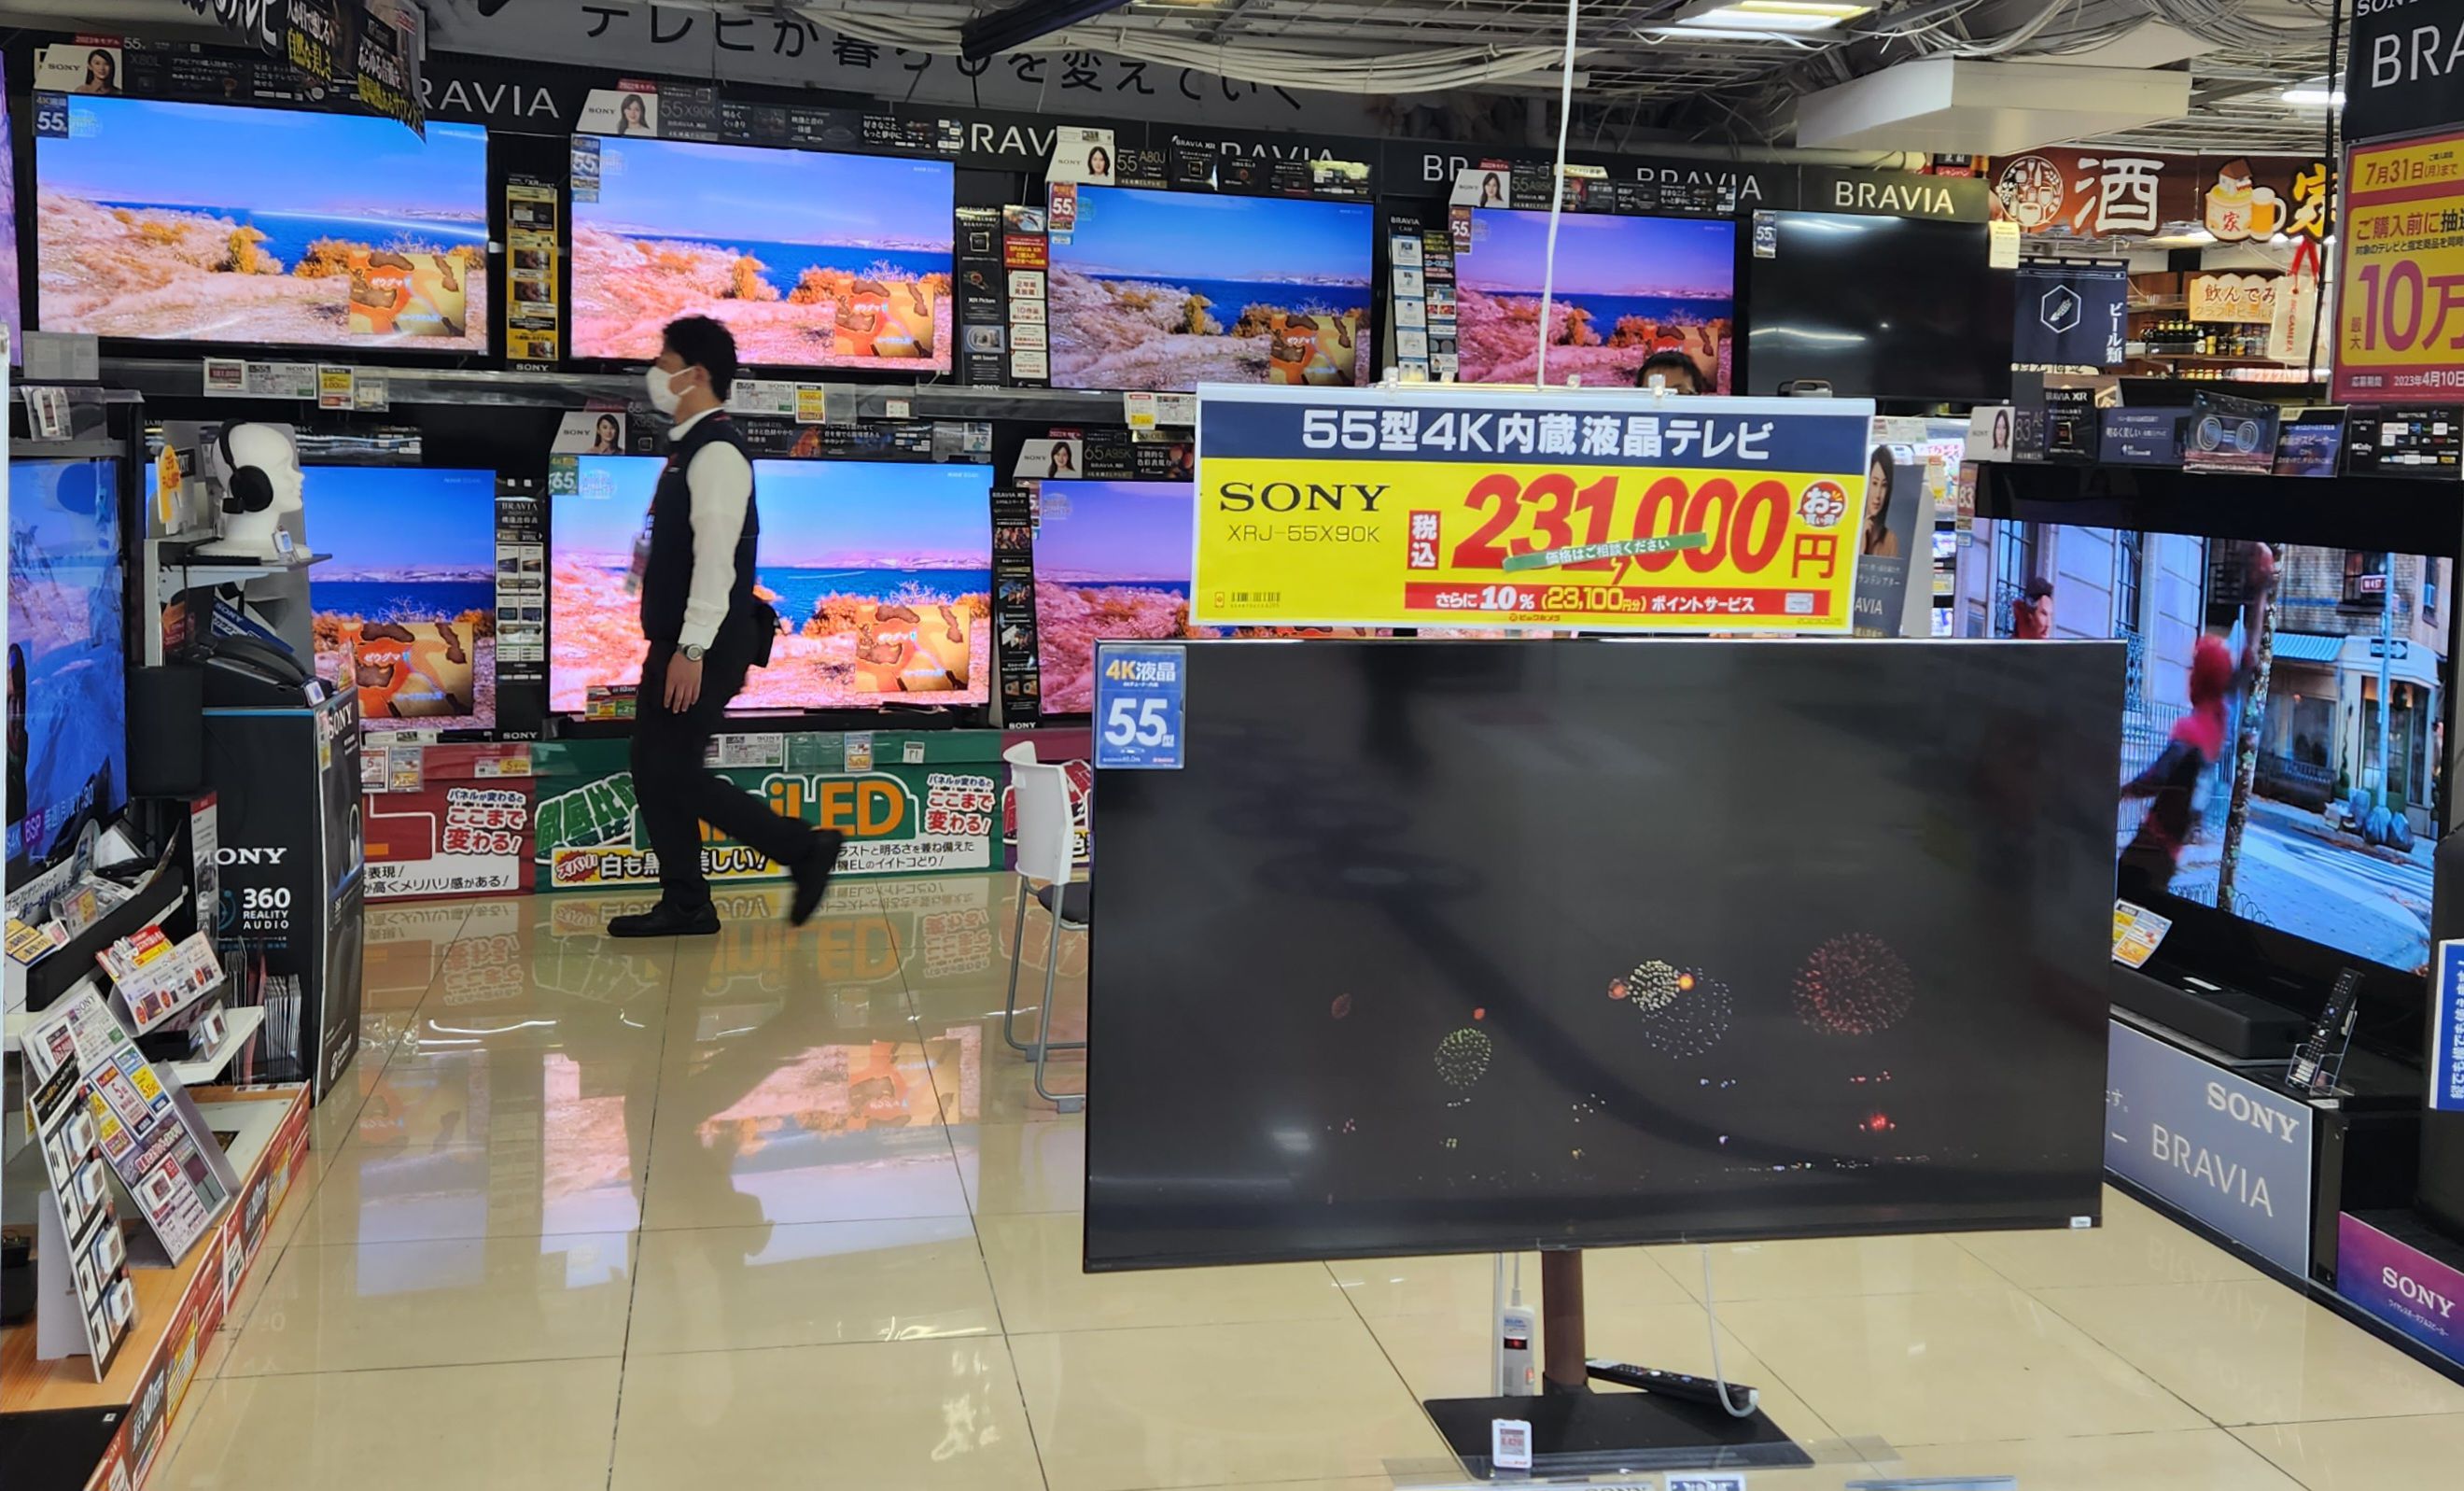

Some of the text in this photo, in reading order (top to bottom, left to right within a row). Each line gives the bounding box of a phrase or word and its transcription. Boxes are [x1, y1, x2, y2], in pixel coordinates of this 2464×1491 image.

[48, 63, 81, 71] SONY
[420, 77, 560, 120] RAVIA
[2365, 158, 2458, 186] 7月31日(月)まで
[1835, 180, 1954, 216] BRAVIA
[2074, 157, 2165, 232] 酒
[1391, 216, 1420, 225] BRAVIA
[2221, 212, 2241, 232] 家
[2357, 207, 2464, 241] ご購入前に抽
[2106, 302, 2123, 363] ビール類
[2350, 316, 2363, 351] 最大
[516, 363, 550, 373] SONY
[2072, 391, 2088, 401] XR
[1302, 409, 1774, 460] 55型4K内蔵液晶テレビ
[501, 501, 539, 511] BRAVIA
[1220, 482, 1391, 512] SONY
[1803, 486, 1843, 514] おっ
[1227, 525, 1380, 543] XRJ-55X90K
[1451, 471, 1791, 585] 231,000
[1409, 513, 1438, 569] 税込
[1546, 539, 1671, 566] 価格はご相談ください
[1792, 533, 1839, 579] 円
[1651, 596, 1756, 612] ポイントサービス
[1105, 658, 1177, 682] 4K液晶
[328, 701, 354, 739] SONY
[1009, 722, 1036, 730] SONY
[502, 731, 539, 739] SONY
[928, 774, 992, 788] パネルが変わると
[449, 790, 524, 804] パネルが変わると
[928, 791, 993, 810] ここまで
[448, 807, 525, 827] ここまで
[926, 810, 991, 834] 変わる!
[446, 827, 520, 851] 変わる!
[215, 847, 287, 866] ONY
[600, 849, 769, 879] 白も黒しい!
[364, 875, 510, 894] が高くメリハリ感がある!
[243, 887, 291, 909] 360
[243, 909, 289, 921] REALITY
[243, 920, 289, 931] AUDIO
[75, 992, 97, 1015] SONY
[2206, 1081, 2300, 1144] SONY
[2152, 1123, 2274, 1217] BRAVIA
[2382, 1266, 2456, 1318] SONY
